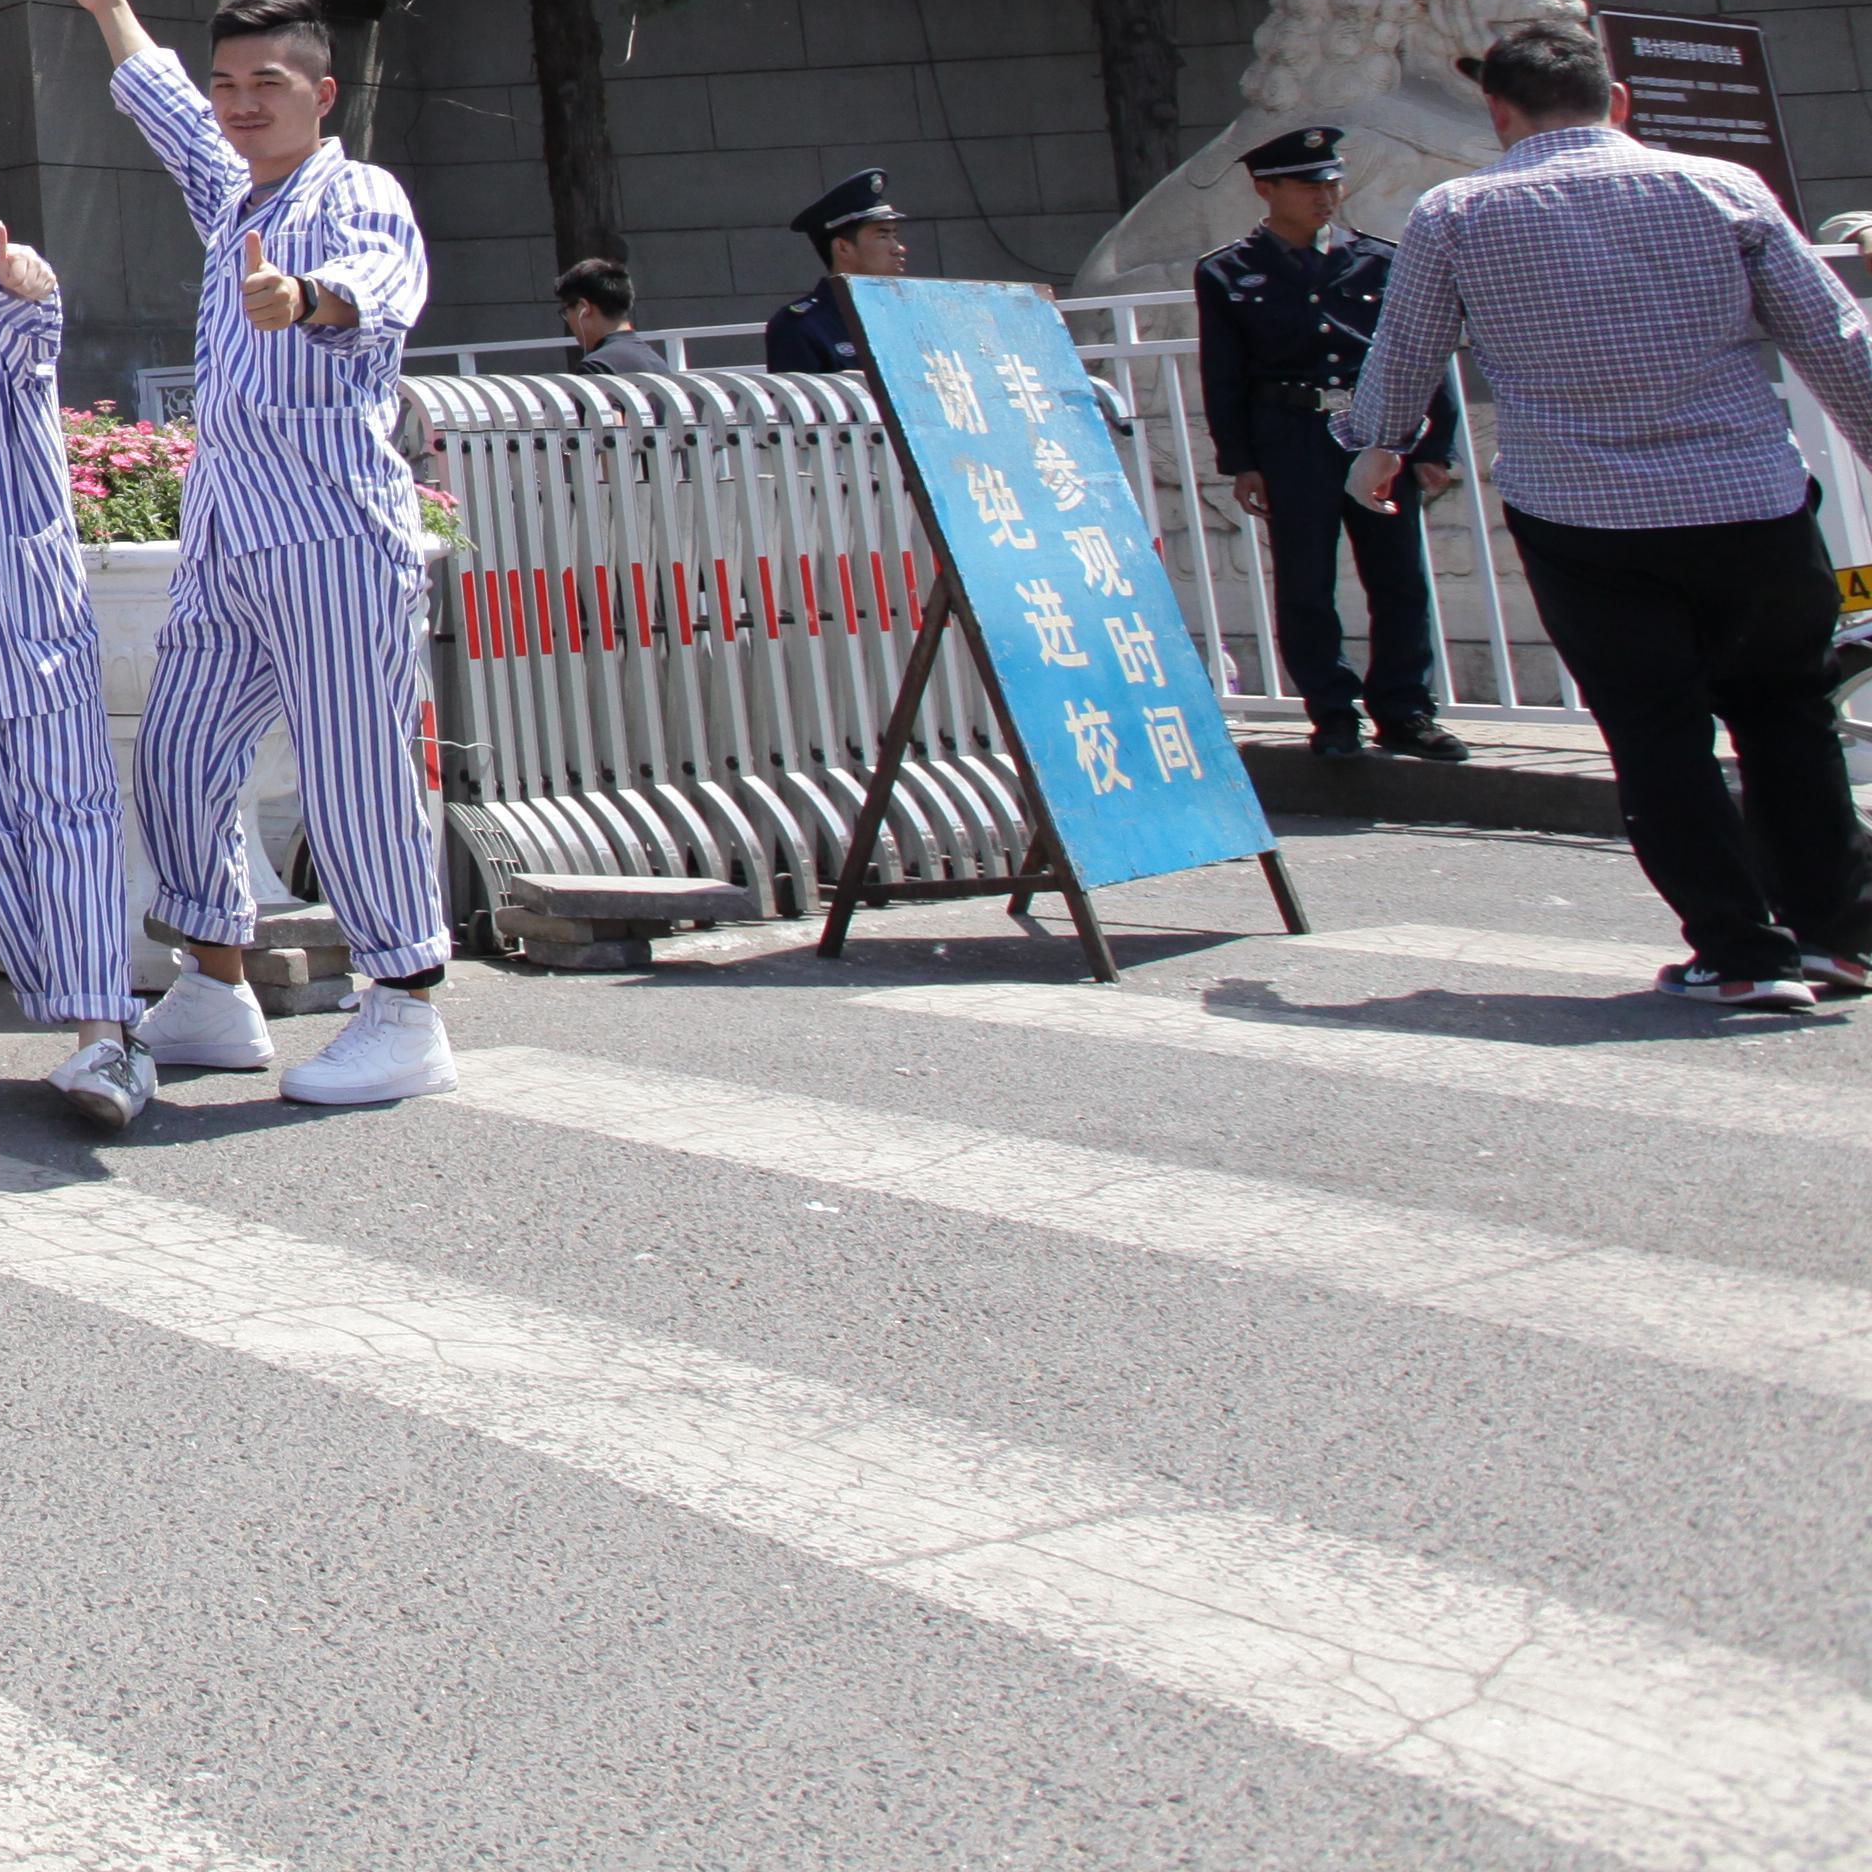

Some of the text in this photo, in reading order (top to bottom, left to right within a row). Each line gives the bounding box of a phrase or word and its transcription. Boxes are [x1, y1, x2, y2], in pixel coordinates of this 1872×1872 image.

[922, 350, 1132, 795] 谢绝进校
[995, 354, 1202, 783] 非参观时间
